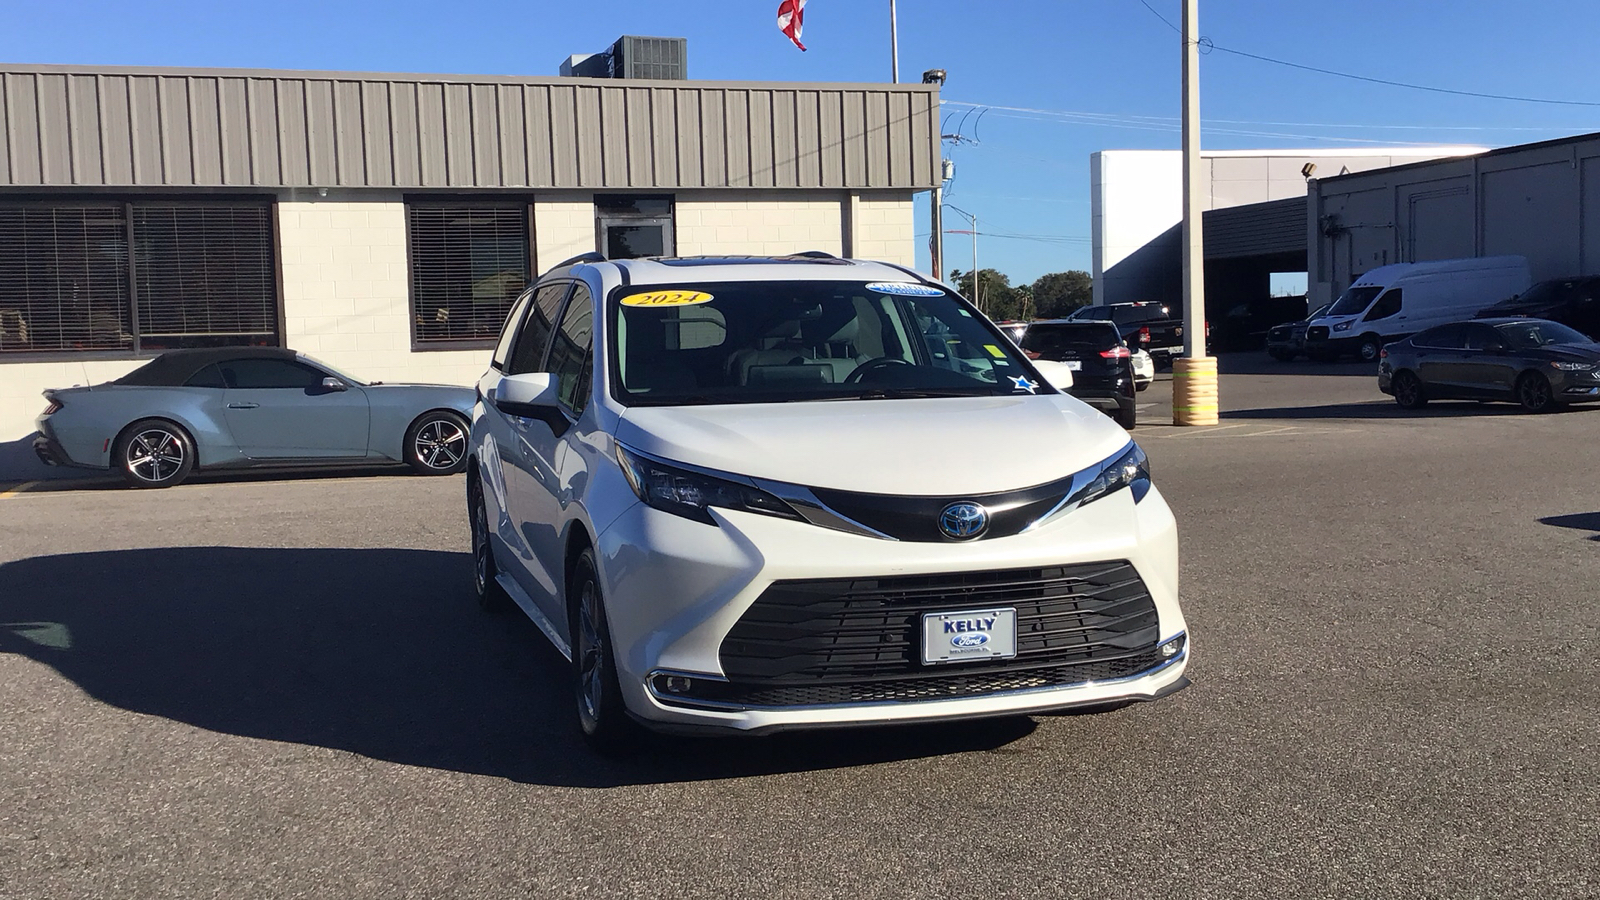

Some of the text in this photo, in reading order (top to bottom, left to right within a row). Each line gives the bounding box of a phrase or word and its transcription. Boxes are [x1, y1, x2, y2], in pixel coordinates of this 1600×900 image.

[637, 293, 700, 305] 2024
[943, 618, 996, 633] KELLY
[958, 636, 983, 646] Ford
